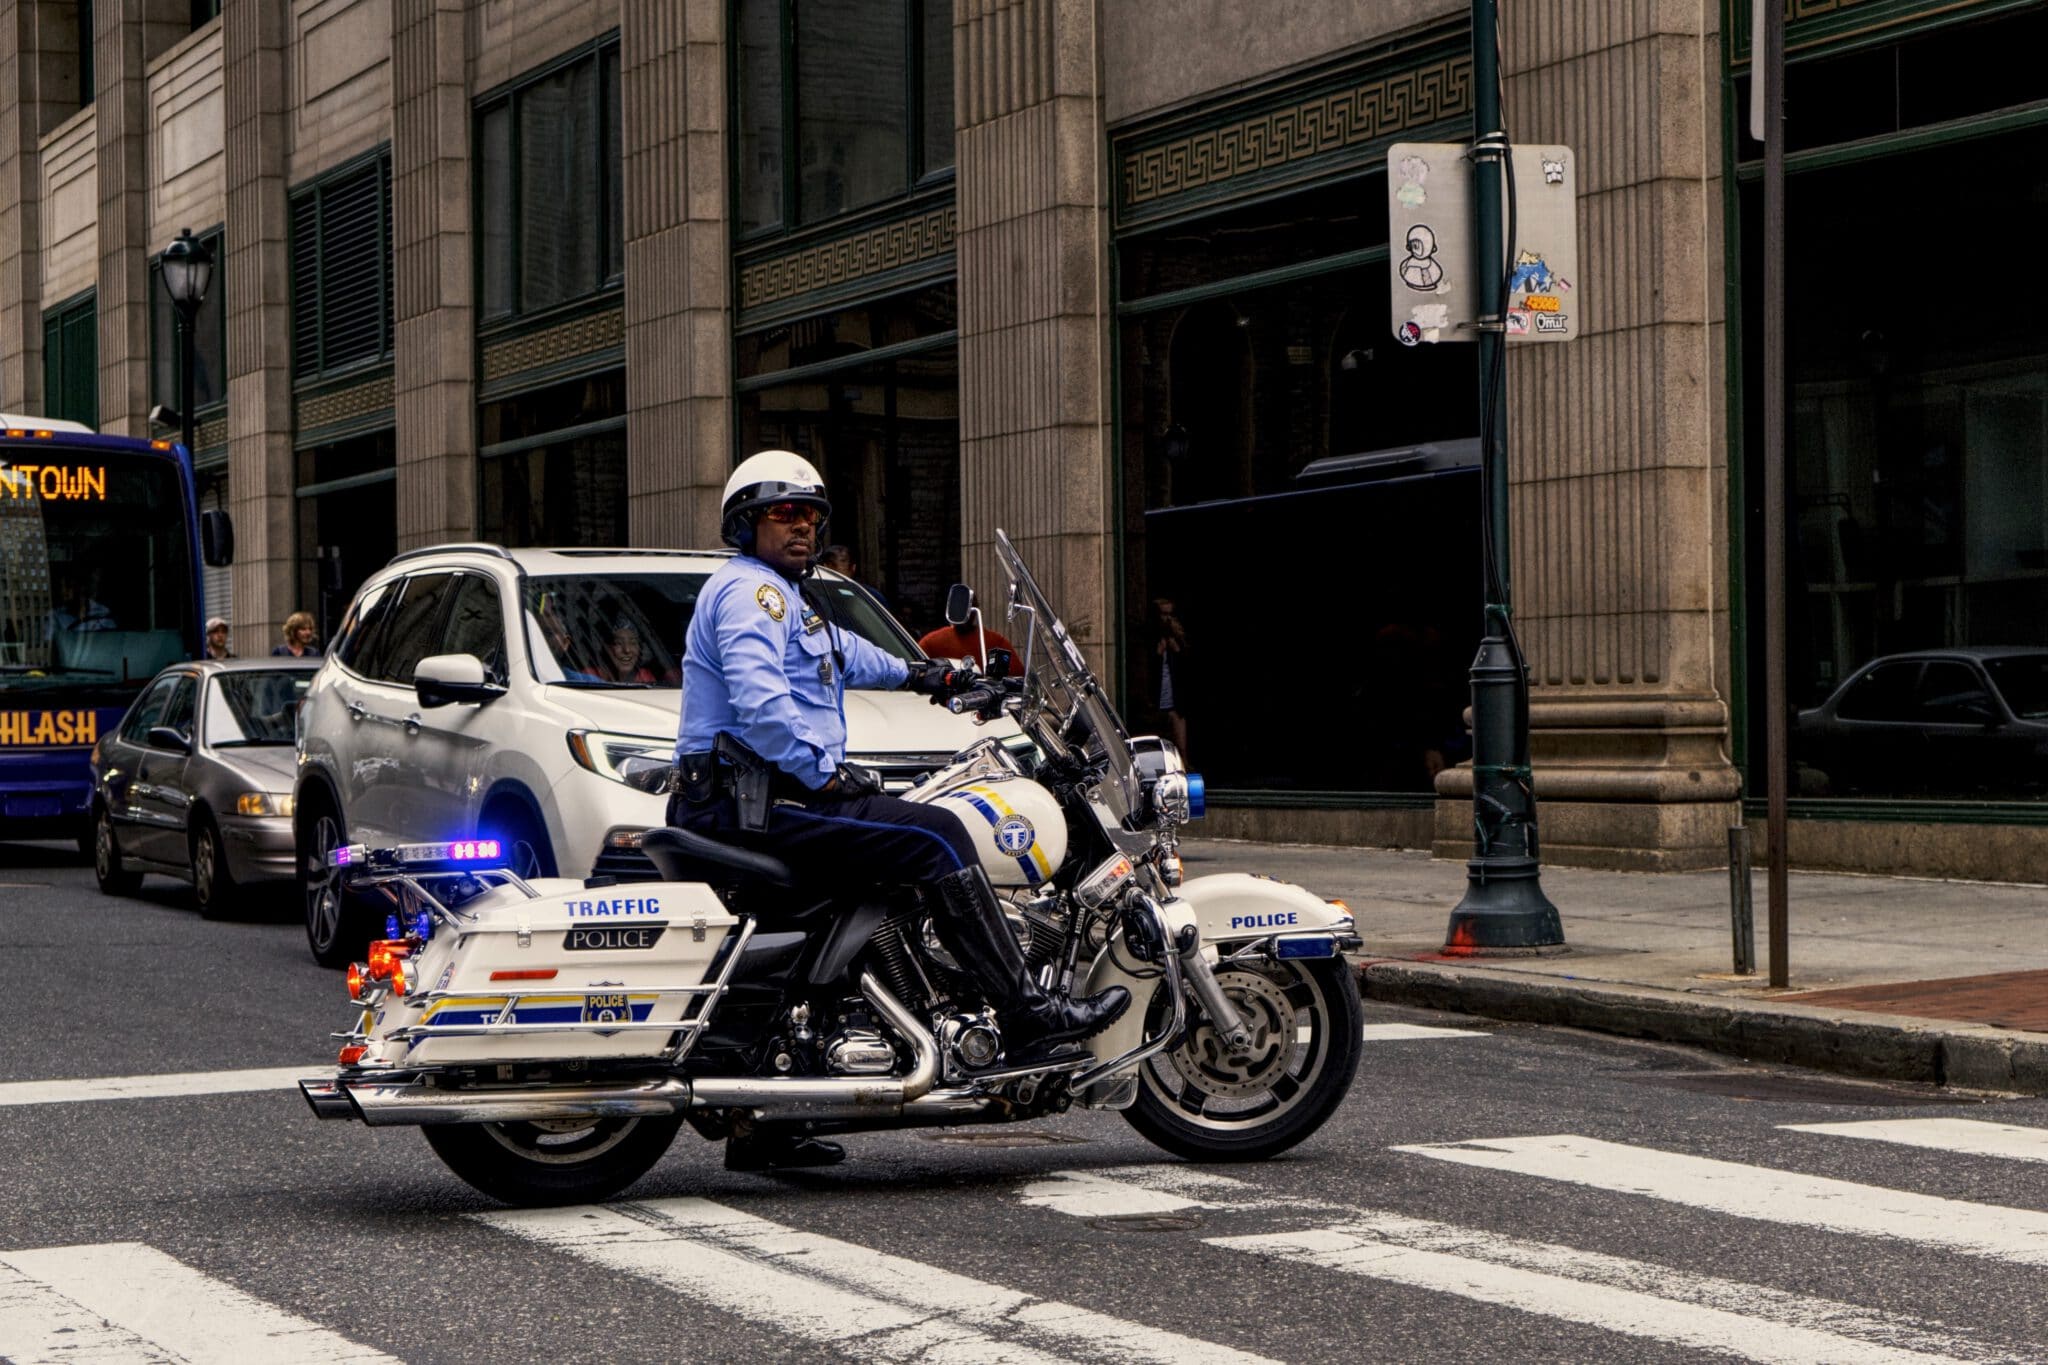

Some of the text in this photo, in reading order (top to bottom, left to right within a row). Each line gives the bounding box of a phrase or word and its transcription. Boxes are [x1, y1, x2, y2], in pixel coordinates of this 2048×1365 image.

[0, 710, 97, 745] HLASH
[563, 898, 660, 917] TRAFFIC
[1231, 912, 1298, 929] POLICE
[572, 930, 650, 949] POLICE
[589, 996, 625, 1009] POLICE
